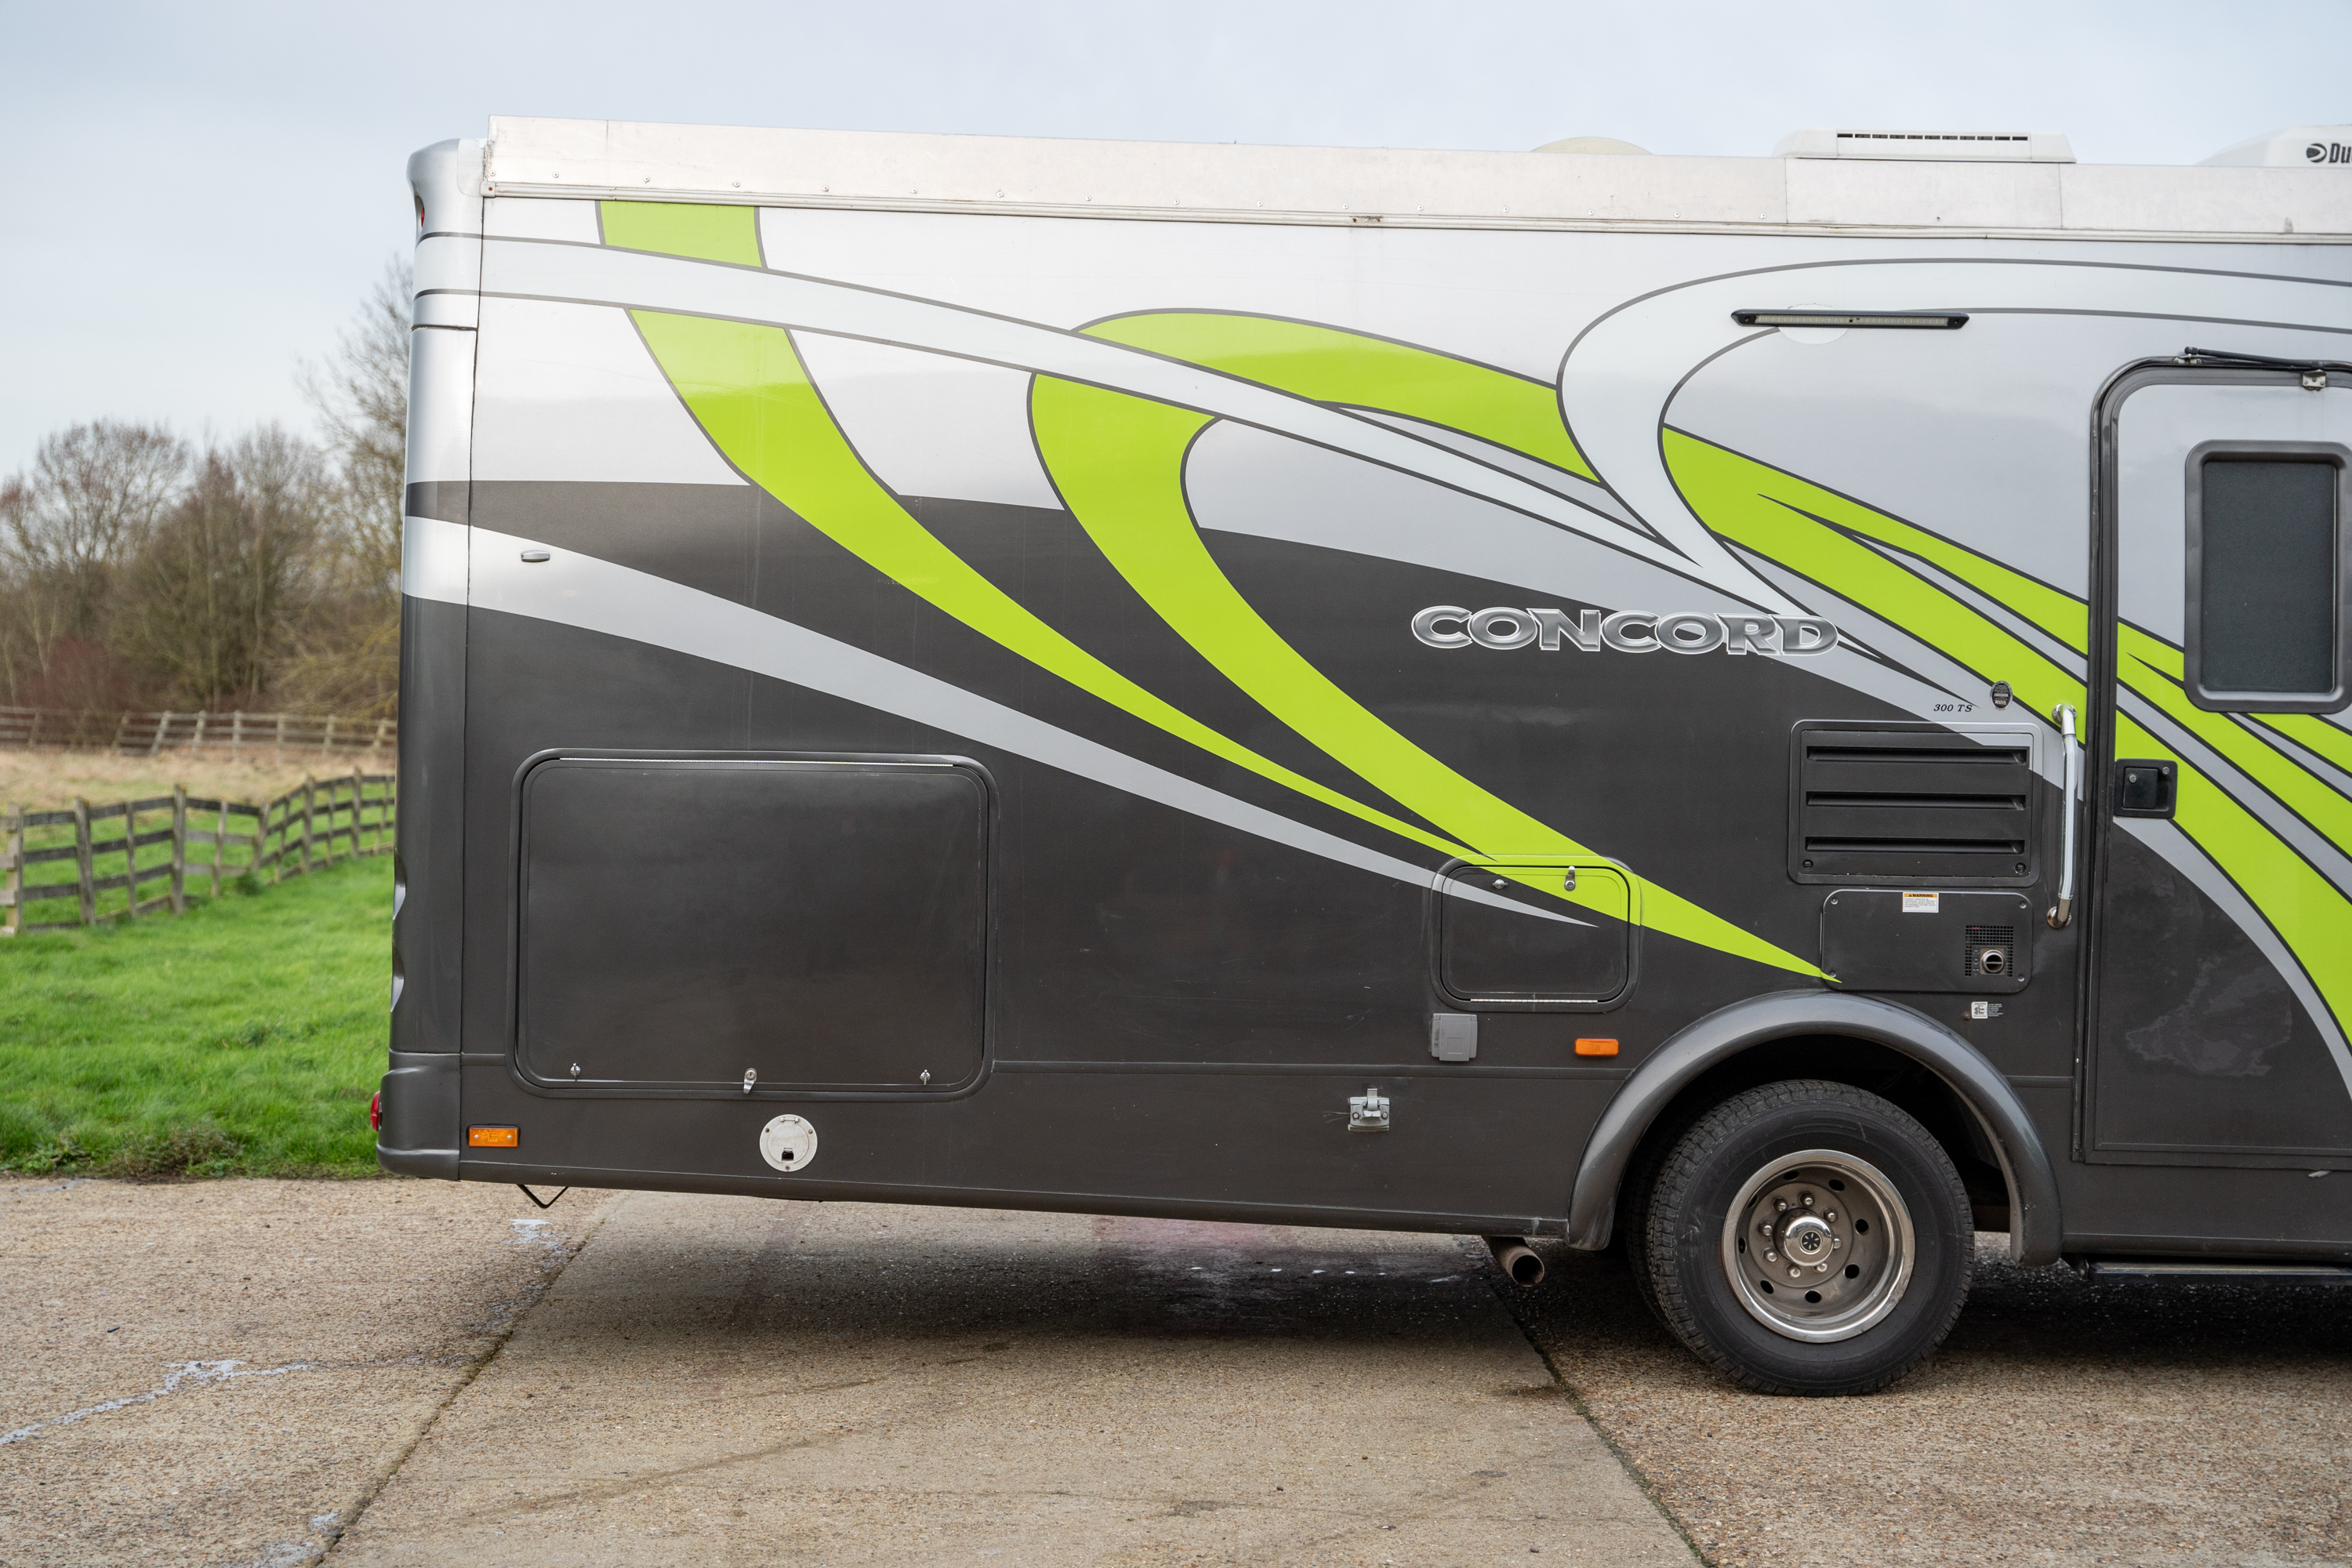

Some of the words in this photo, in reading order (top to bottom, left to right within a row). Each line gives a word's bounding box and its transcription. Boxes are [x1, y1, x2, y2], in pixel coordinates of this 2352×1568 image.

[1411, 605, 1839, 655] CONCORD
[1933, 703, 1954, 712] 300
[1957, 704, 1973, 713] TS
